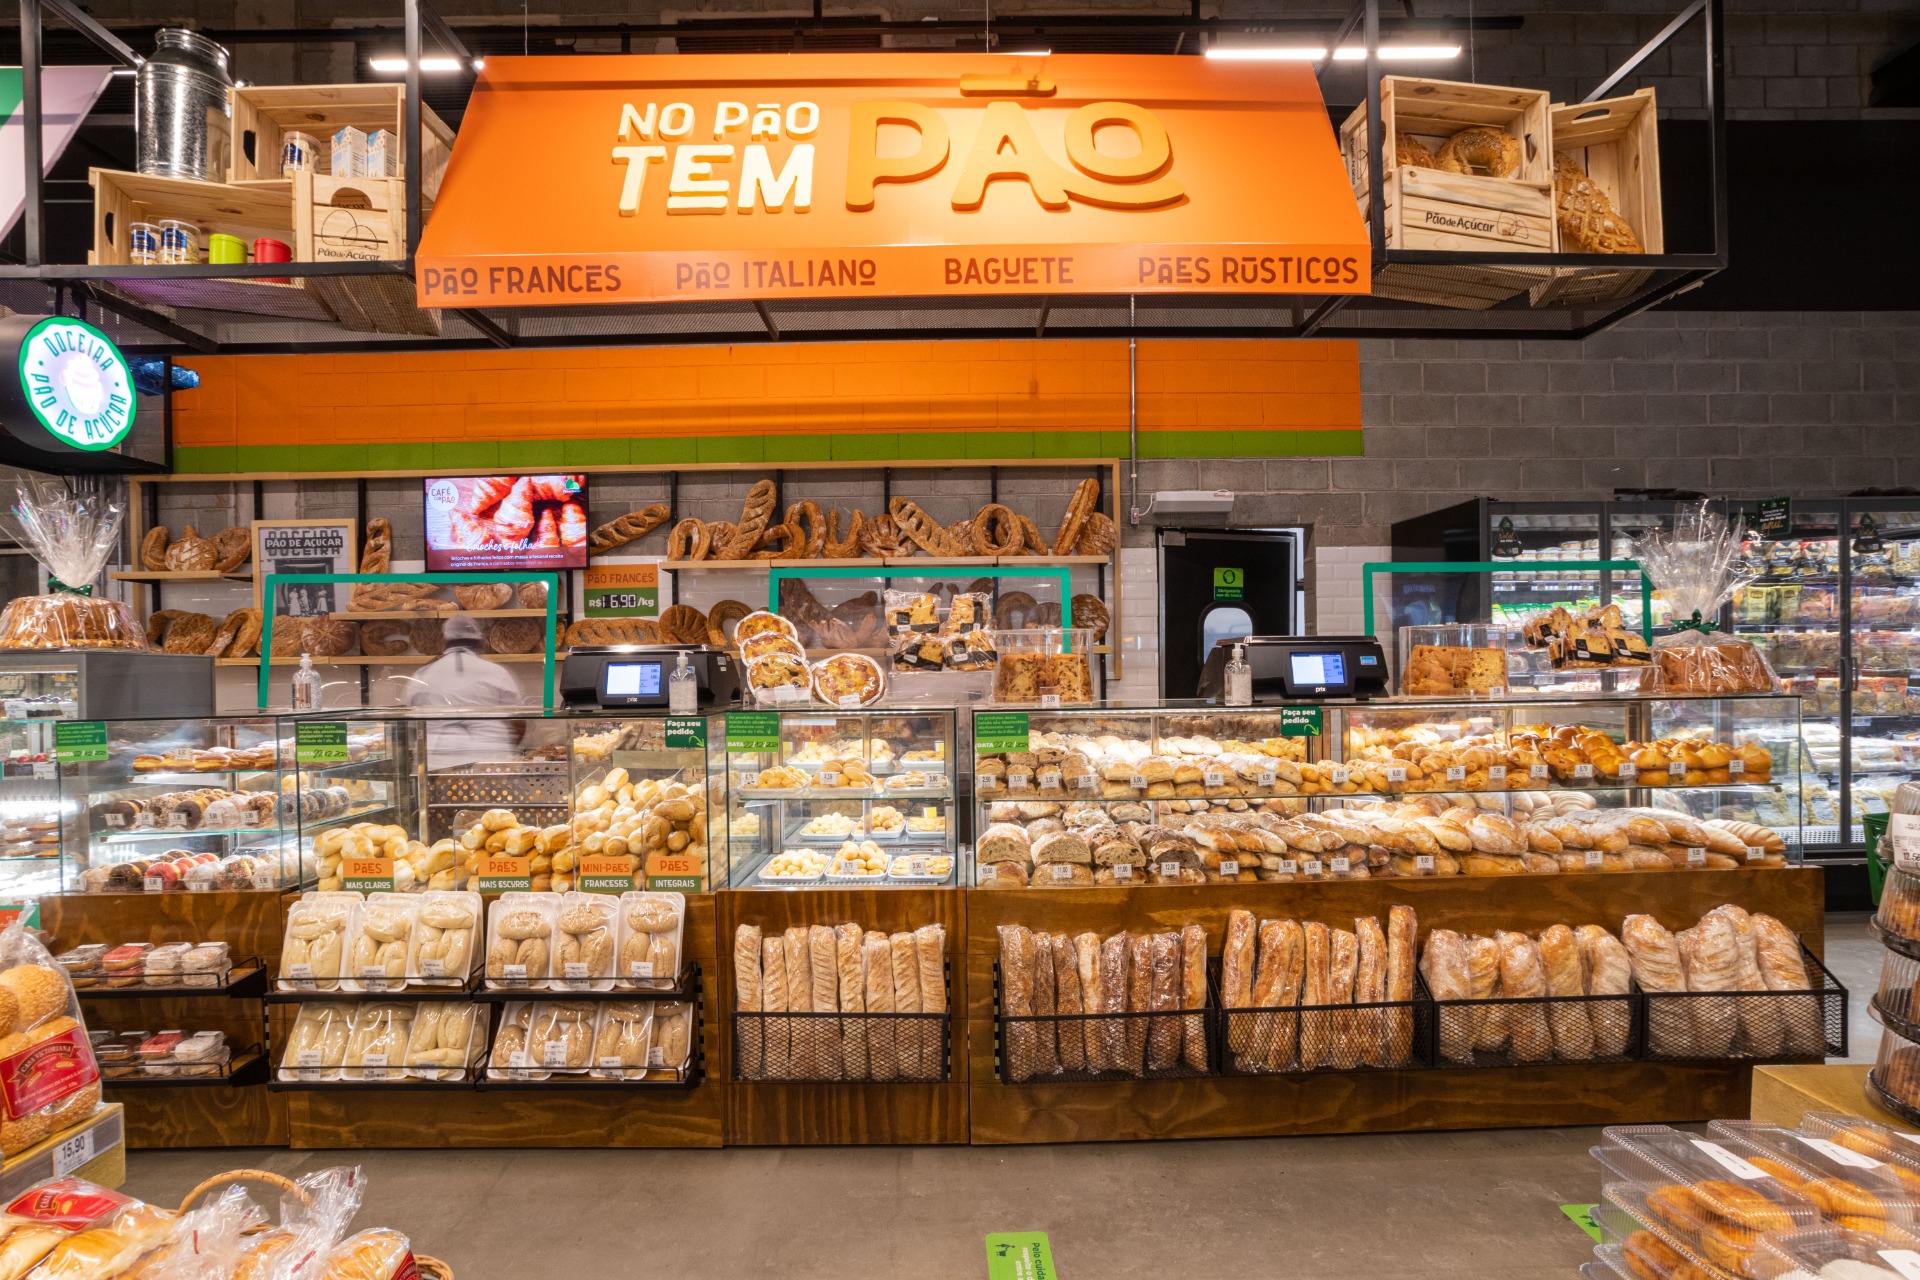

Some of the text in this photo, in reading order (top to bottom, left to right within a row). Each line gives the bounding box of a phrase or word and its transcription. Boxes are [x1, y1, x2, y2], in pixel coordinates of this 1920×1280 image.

[618, 101, 820, 142] NO PÃO
[611, 144, 815, 217] TEM
[1425, 212, 1495, 232] Pão de Açúcar
[317, 247, 336, 258] Pão
[676, 258, 877, 290] PÃO ITALIANO
[945, 256, 1074, 285] BAGUETE
[424, 262, 478, 295] PÃO
[43, 331, 115, 371] DOCEIRA
[56, 409, 77, 435] DE
[289, 539, 302, 547] DE
[1282, 709, 1301, 717] Faça
[667, 720, 685, 728] Faça
[1282, 716, 1310, 725] pedido
[667, 728, 695, 737] pedido
[346, 881, 391, 889] MAIS CLAROS
[498, 880, 529, 888] ESCUROS
[585, 880, 629, 888] FRANCESES
[656, 880, 695, 888] INTEGRAIS
[62, 1135, 85, 1160] 15,90
